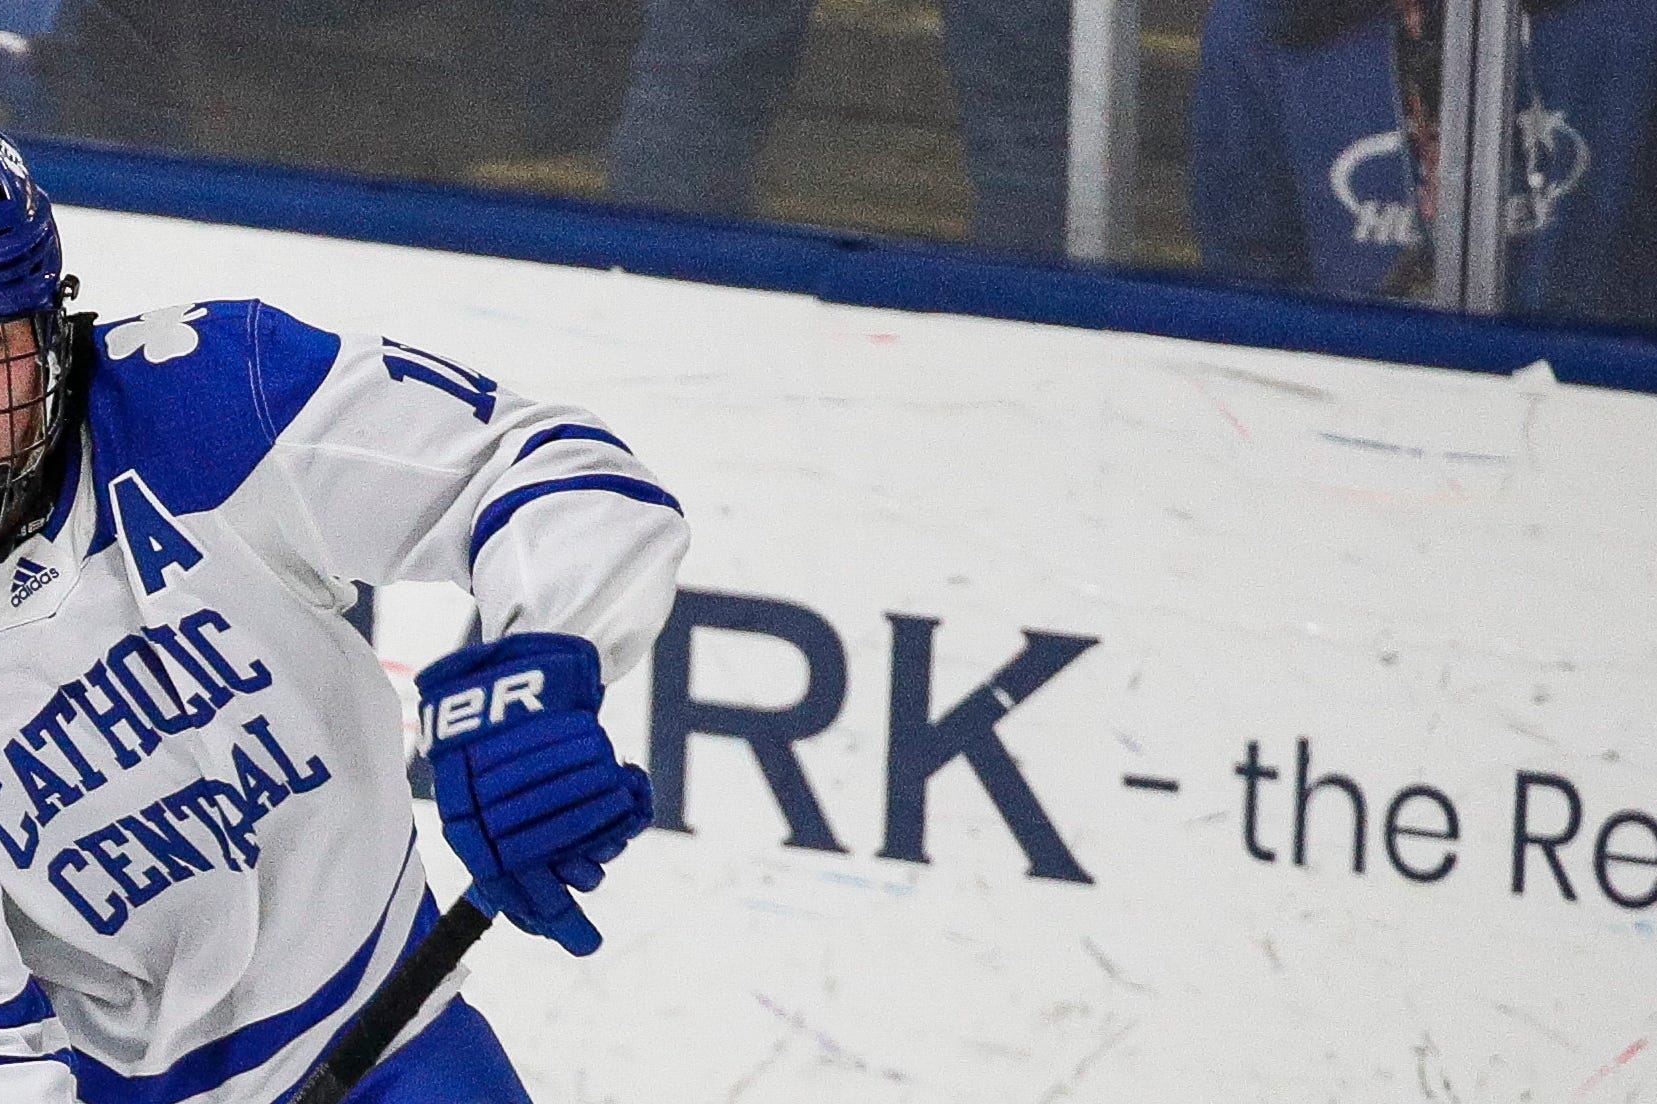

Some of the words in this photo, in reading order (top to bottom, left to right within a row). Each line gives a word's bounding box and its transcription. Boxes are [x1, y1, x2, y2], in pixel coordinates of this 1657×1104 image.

[10, 566, 60, 608] adidas
[109, 470, 205, 597] A
[47, 714, 332, 936] CENTRAL
[1234, 736, 1460, 885] the
